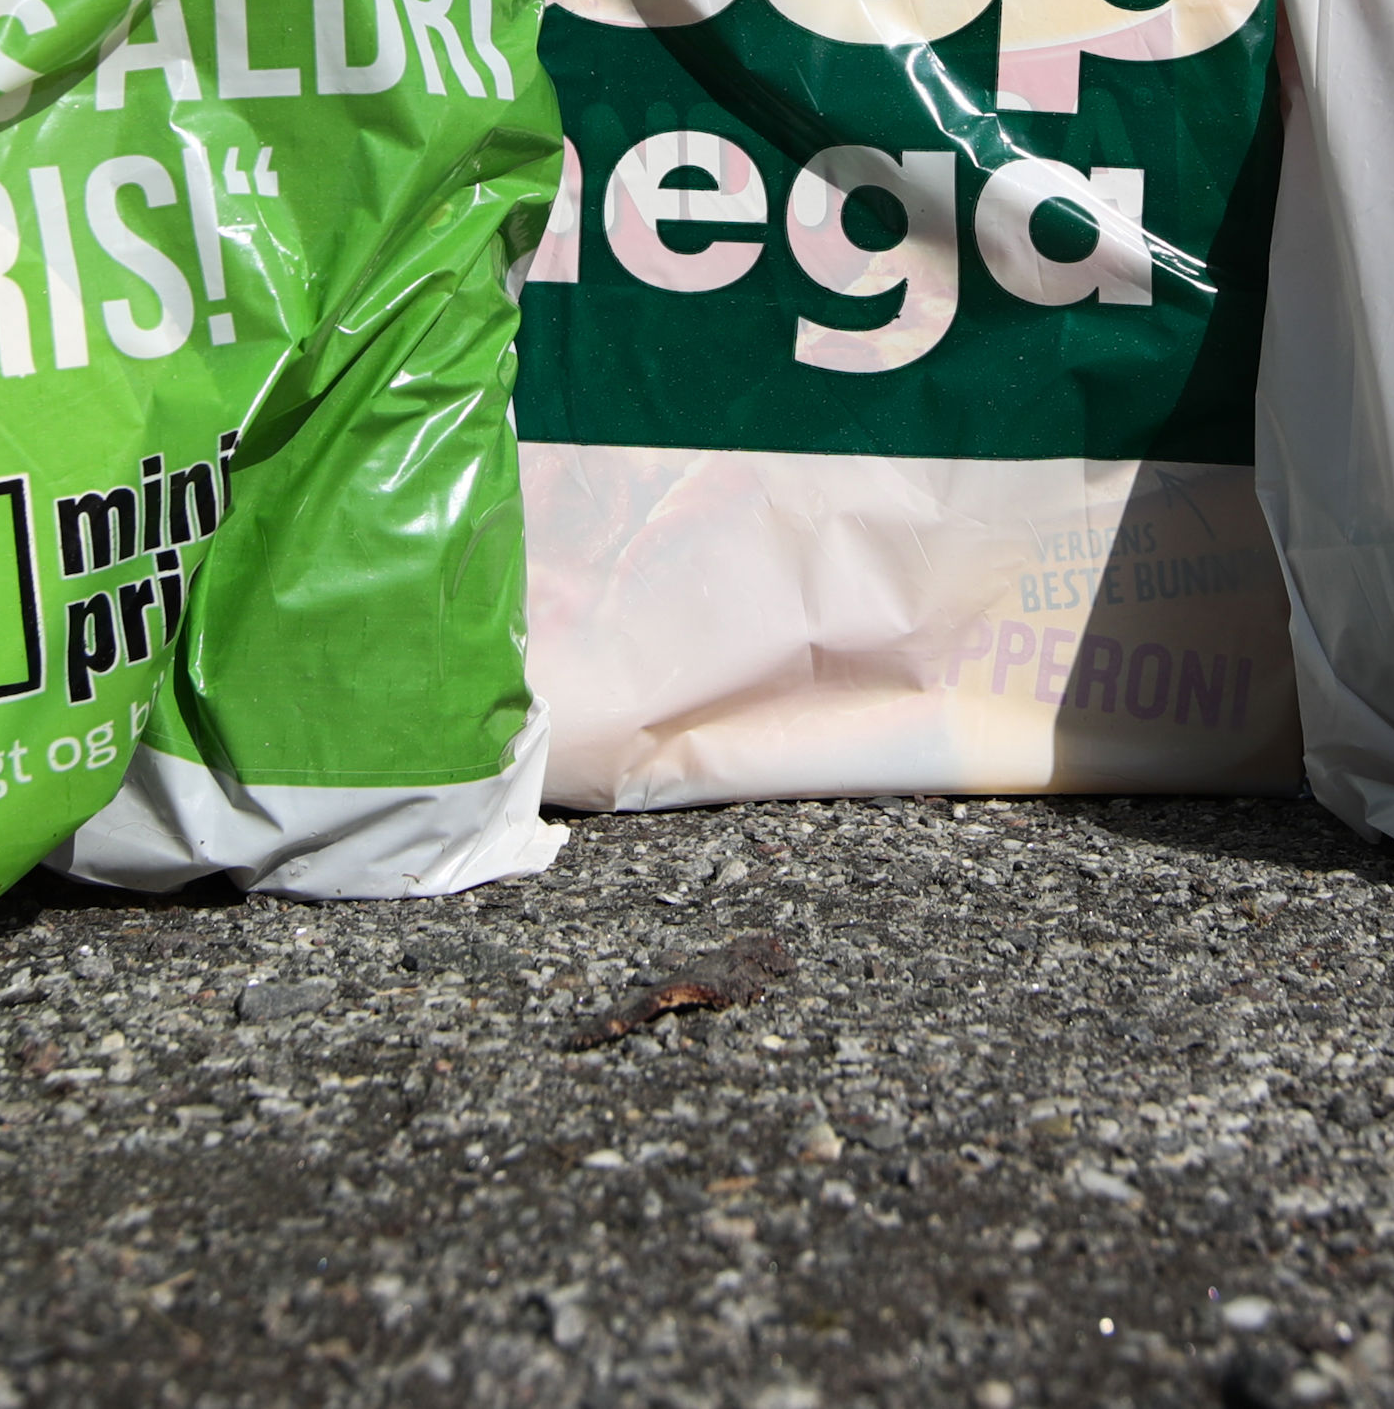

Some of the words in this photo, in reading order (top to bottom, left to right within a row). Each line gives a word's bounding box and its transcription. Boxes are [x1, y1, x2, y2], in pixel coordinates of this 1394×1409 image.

[54, 428, 242, 580] mini
[65, 547, 187, 707] pri
[943, 618, 1255, 730] PPERONI
[47, 719, 118, 772] og
